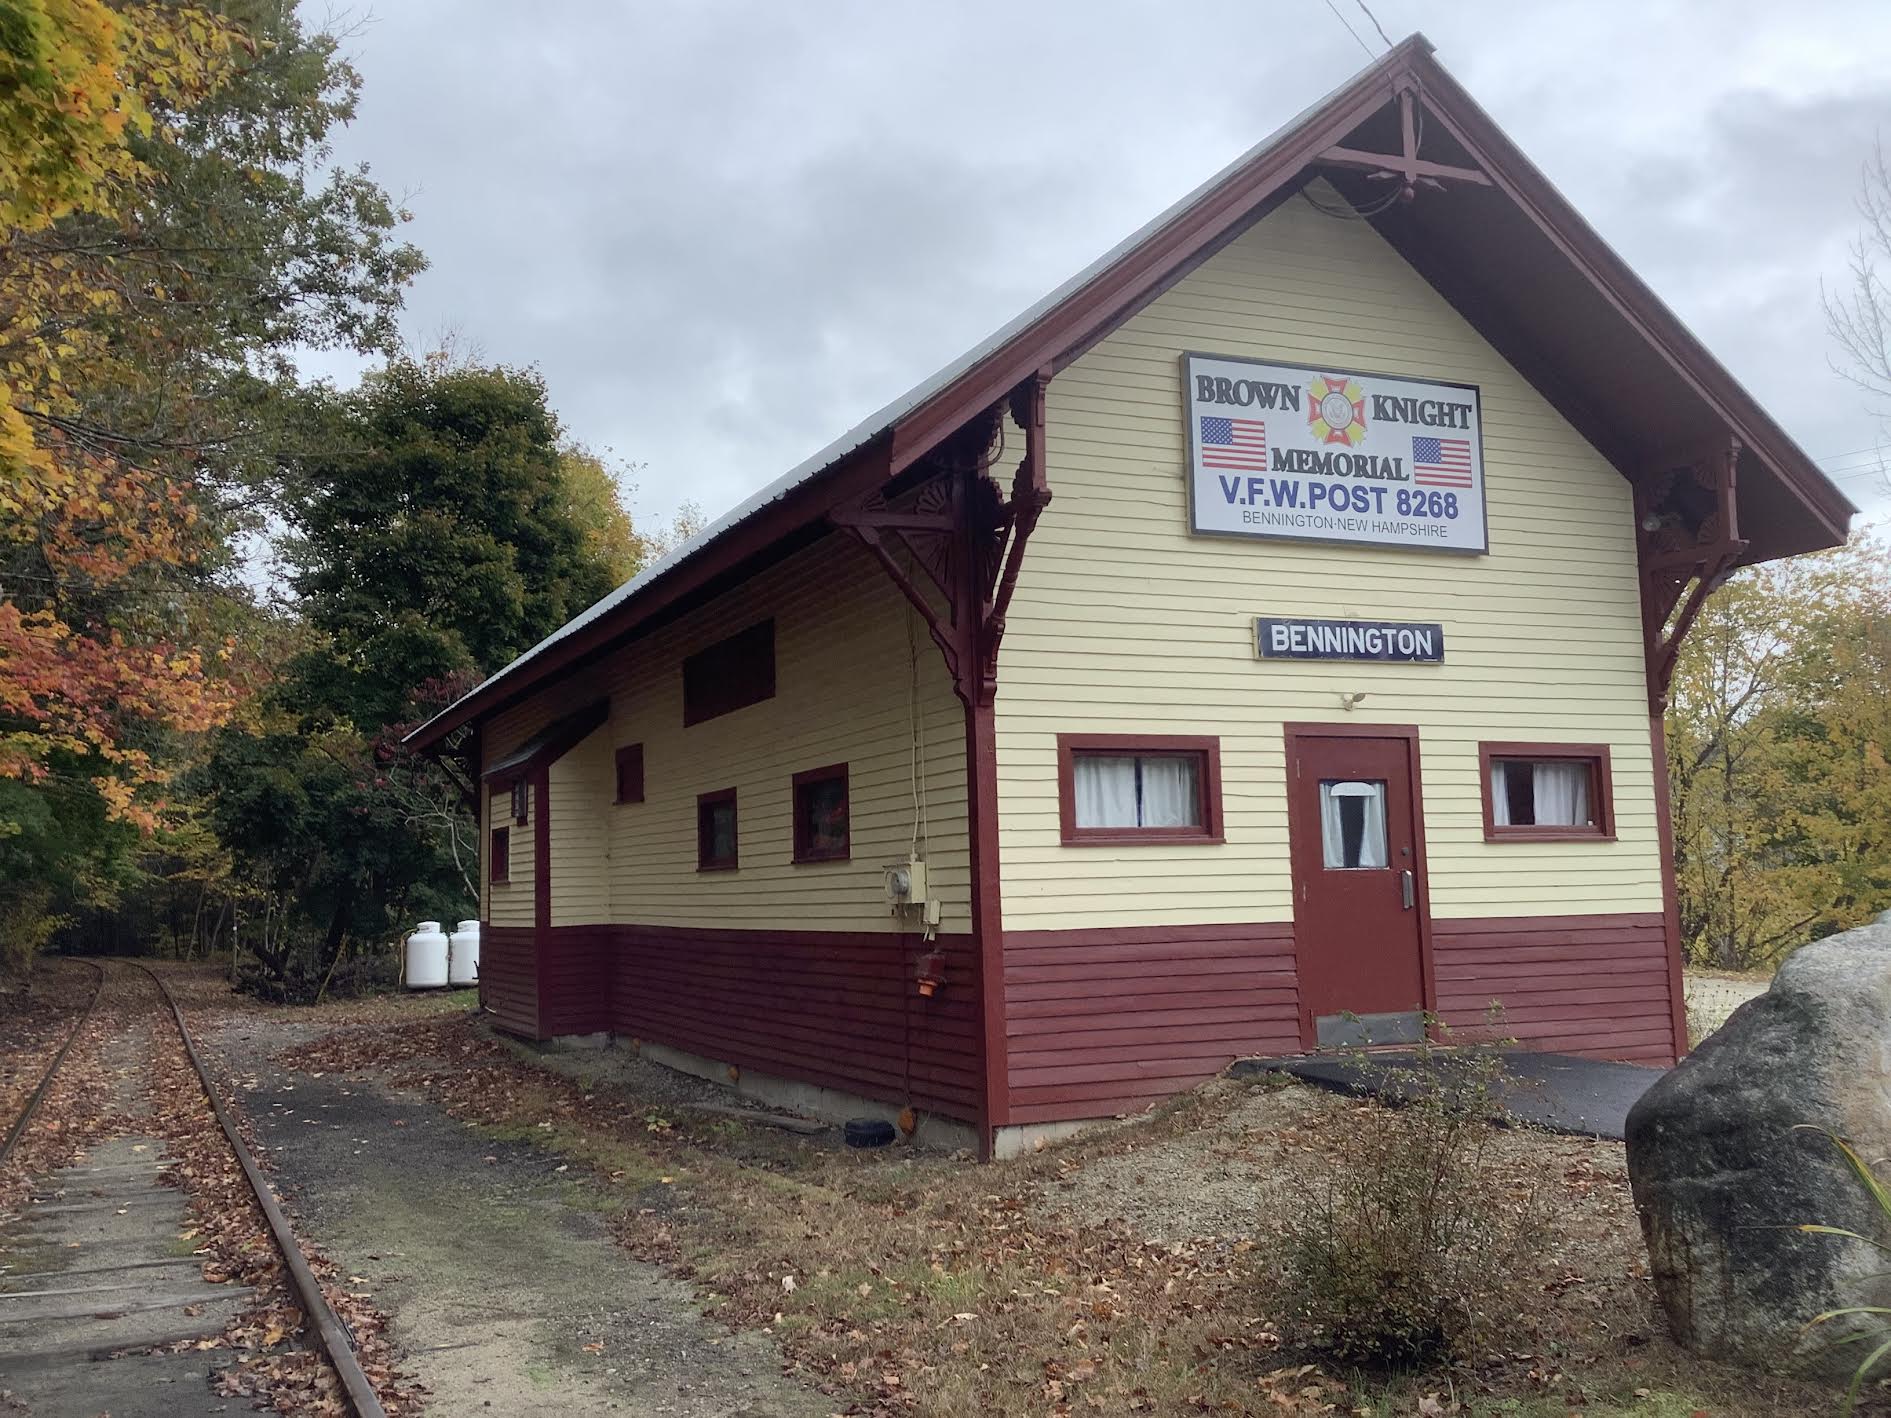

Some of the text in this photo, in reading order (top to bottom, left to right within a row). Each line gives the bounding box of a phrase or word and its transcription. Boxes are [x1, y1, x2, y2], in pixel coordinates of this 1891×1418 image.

[1196, 375, 1301, 412] BROWN
[1371, 394, 1472, 430] KNIGHT
[1271, 448, 1409, 482] MEMORIAL
[1396, 490, 1459, 520] 8268
[1372, 520, 1448, 538] HAMPSHIRE
[1271, 624, 1433, 656] BENNINGTON
